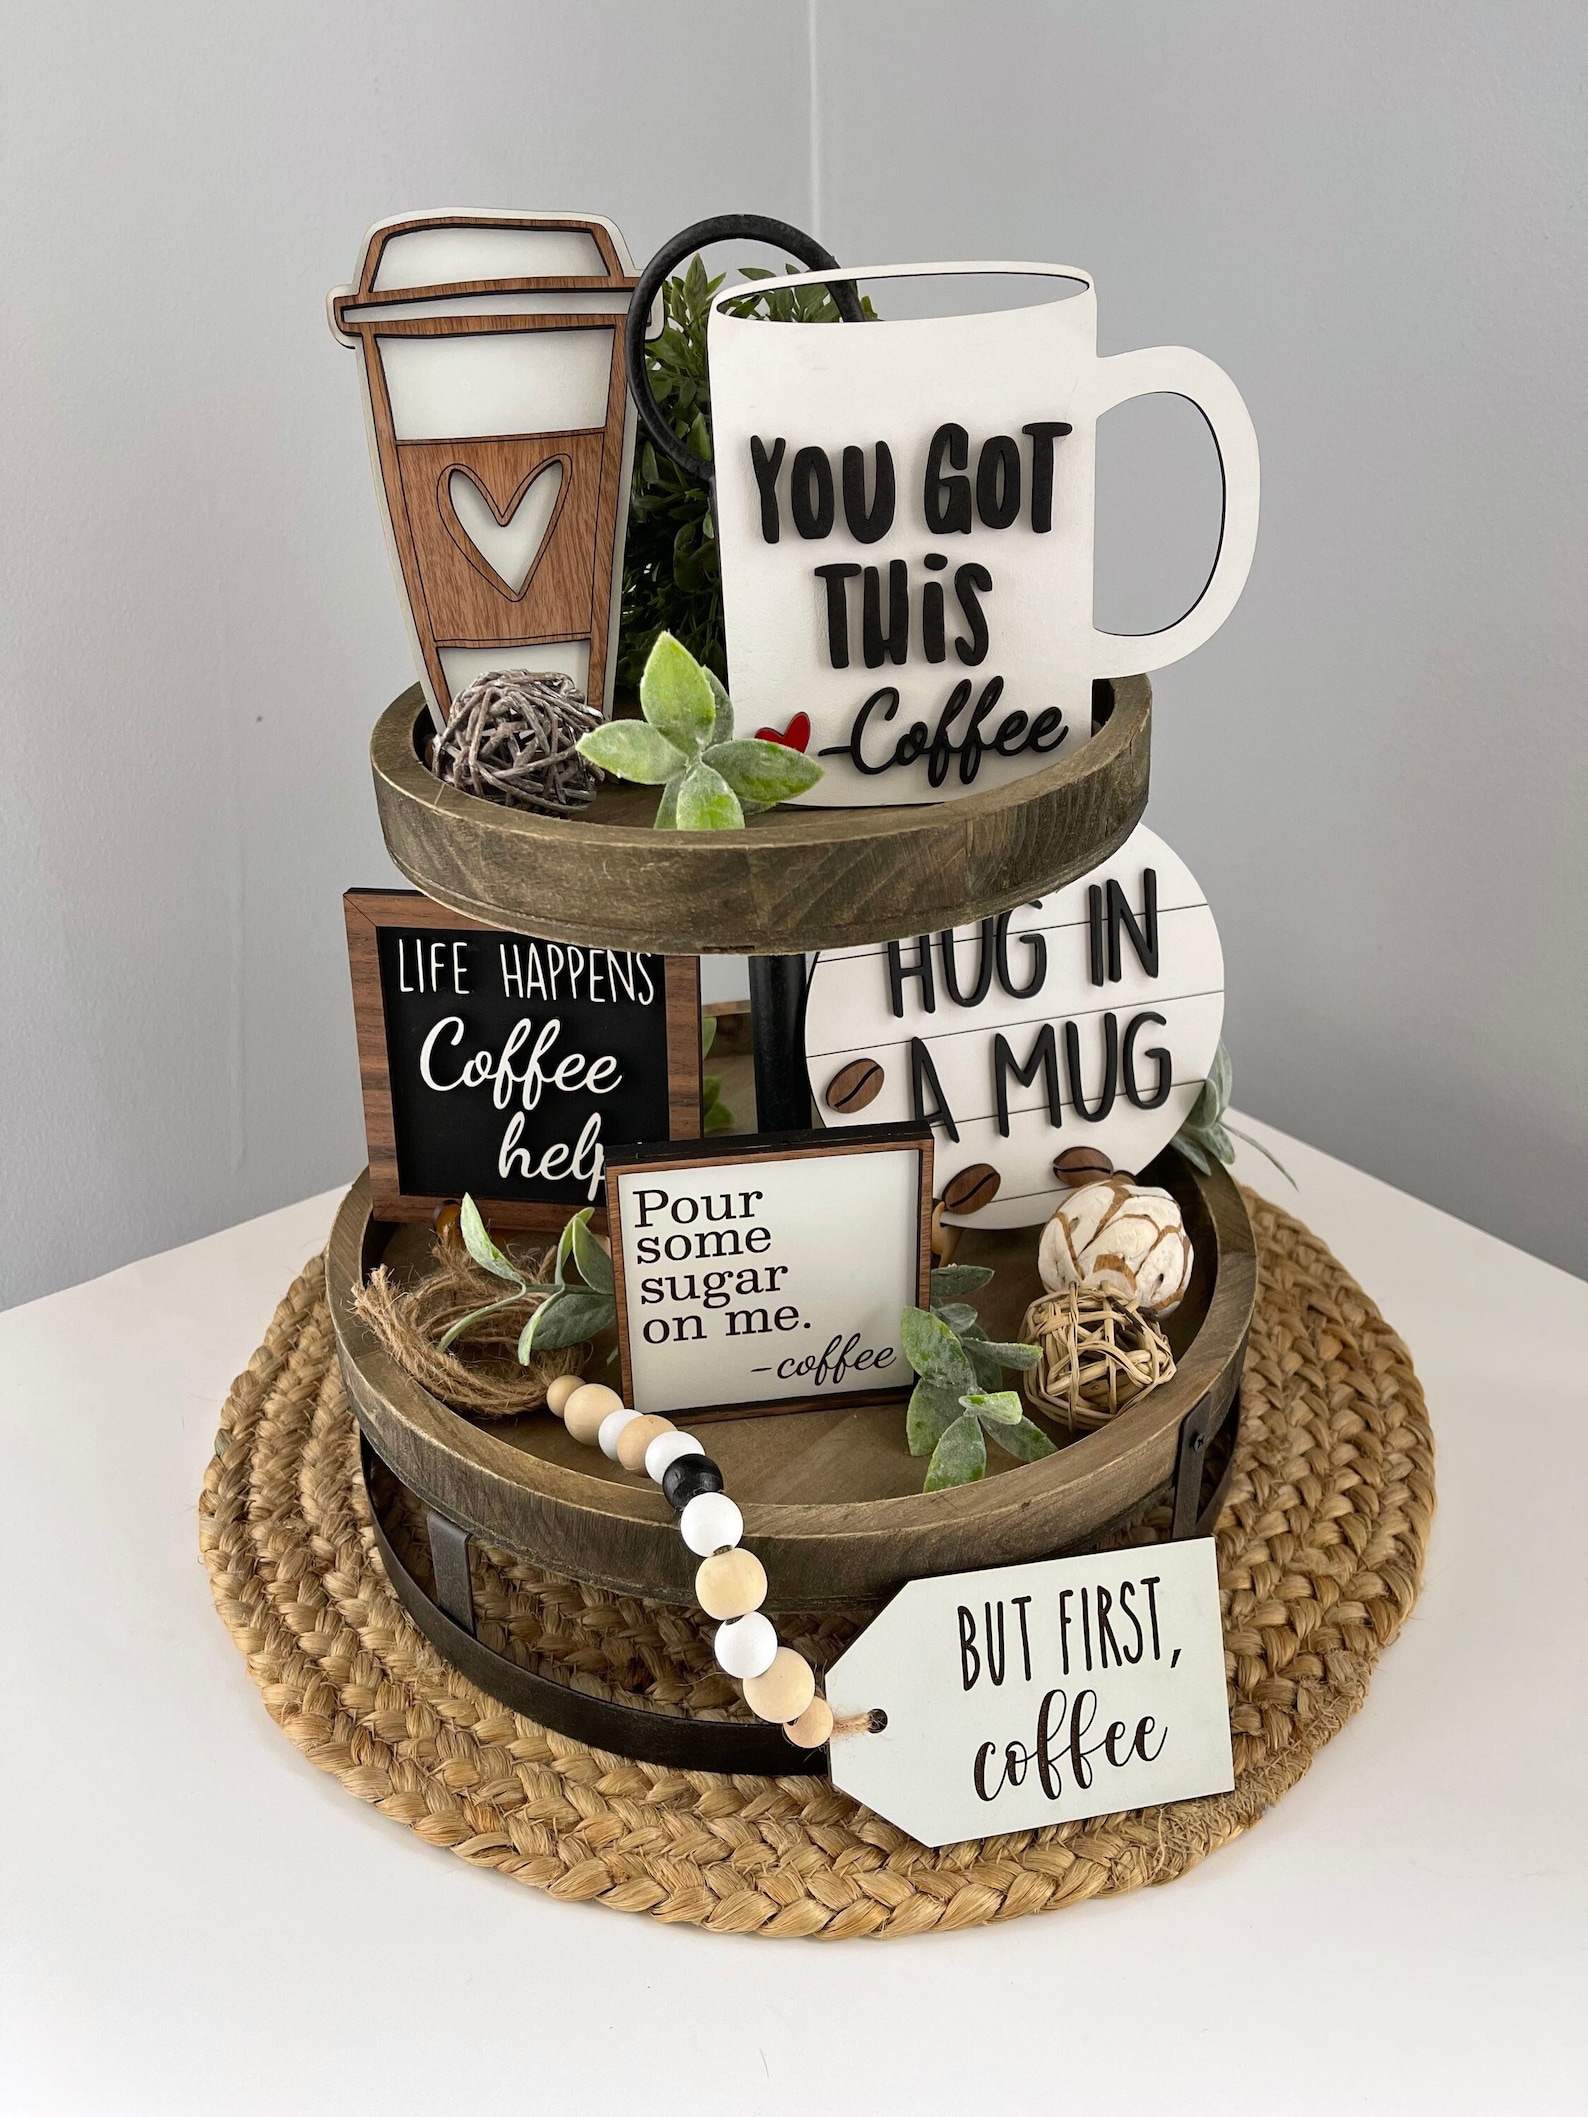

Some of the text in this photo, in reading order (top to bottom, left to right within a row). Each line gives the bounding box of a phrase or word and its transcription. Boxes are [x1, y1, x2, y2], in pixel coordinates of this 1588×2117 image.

[750, 421, 1073, 544] YOU GOT
[398, 938, 655, 1006] LIFE HAPPENS
[887, 868, 1159, 1018] HUG IN
[419, 1016, 623, 1111] Coffee
[911, 1011, 1173, 1144] A MUG
[631, 1188, 764, 1229] Pour
[636, 1225, 772, 1265] some
[640, 1264, 789, 1309] sugar
[642, 1303, 812, 1345] on me.
[957, 1575, 1183, 1691] BUT FIRST,
[973, 1688, 1169, 1802] coffee
